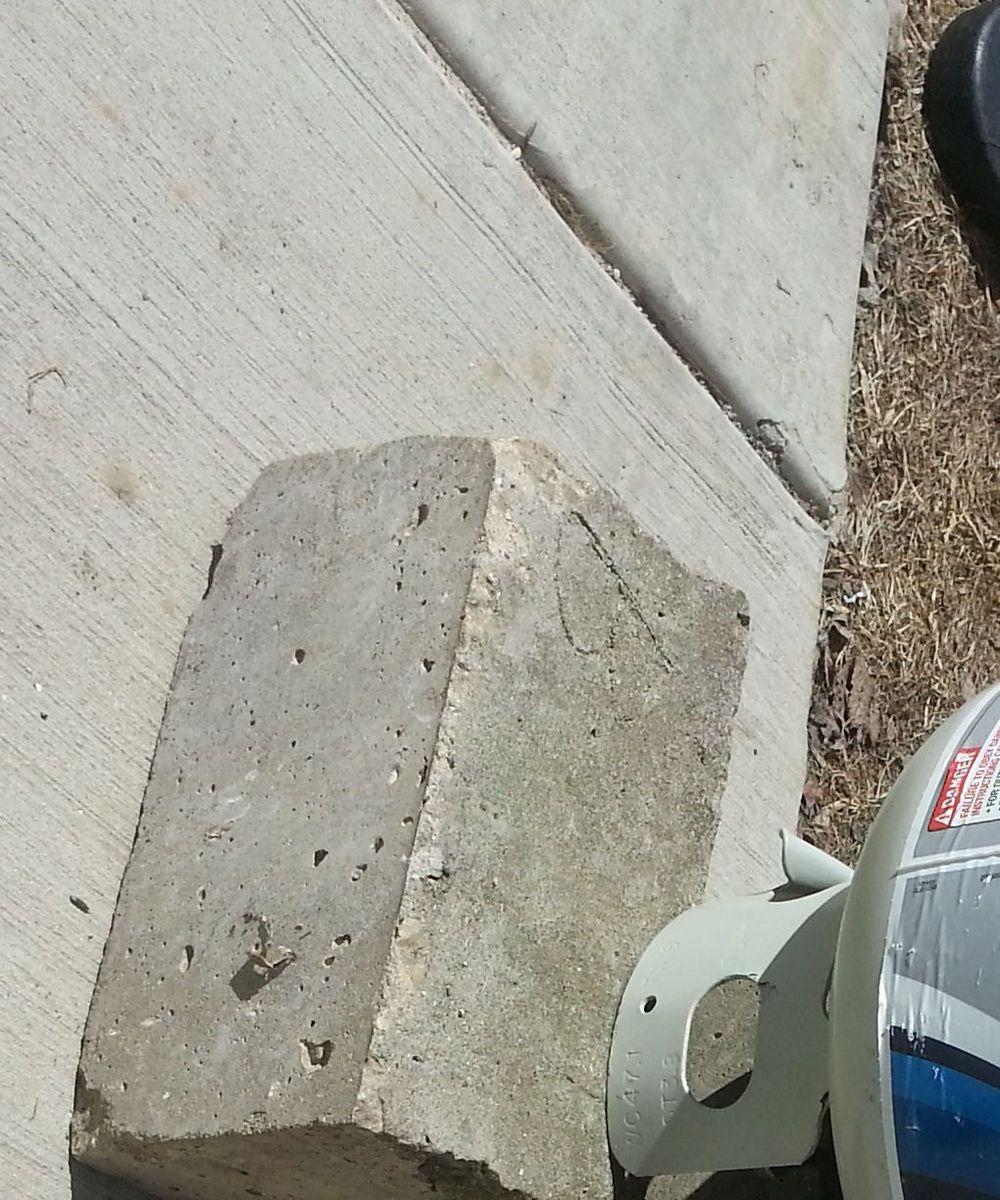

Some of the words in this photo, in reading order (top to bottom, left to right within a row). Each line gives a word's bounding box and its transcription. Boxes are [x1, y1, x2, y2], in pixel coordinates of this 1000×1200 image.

[941, 752, 976, 809] DANGER
[960, 782, 979, 818] FAILURE
[973, 770, 985, 780] TO
[971, 758, 1000, 816] INSTRUCTIONS
[986, 789, 1000, 807] FOR
